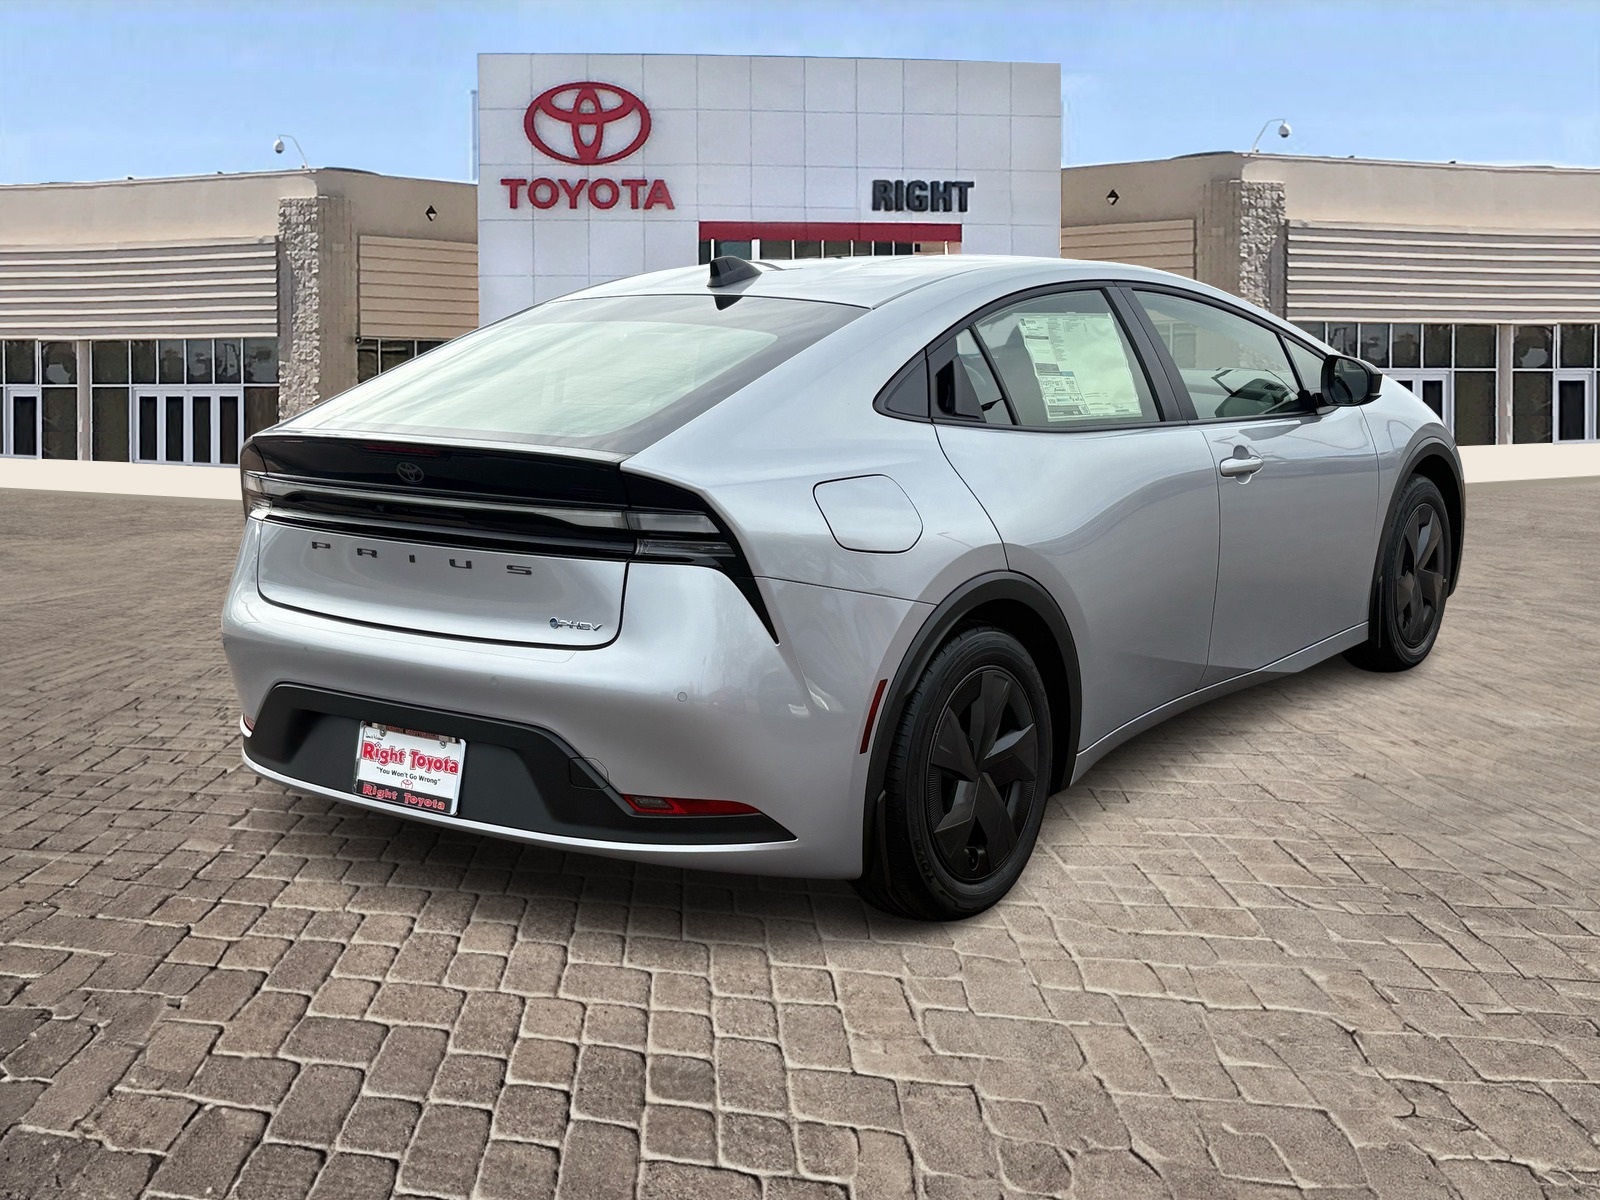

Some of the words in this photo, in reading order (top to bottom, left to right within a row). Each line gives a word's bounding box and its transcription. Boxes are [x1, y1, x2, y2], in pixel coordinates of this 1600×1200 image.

[500, 178, 675, 210] TOYOTA
[872, 179, 974, 212] RIGHT
[312, 541, 532, 575] PRIUS
[362, 741, 406, 766] Right
[409, 748, 459, 775] Toyota
[391, 770, 408, 779] Won't
[362, 783, 398, 799] Right
[403, 792, 446, 811] Toyota
